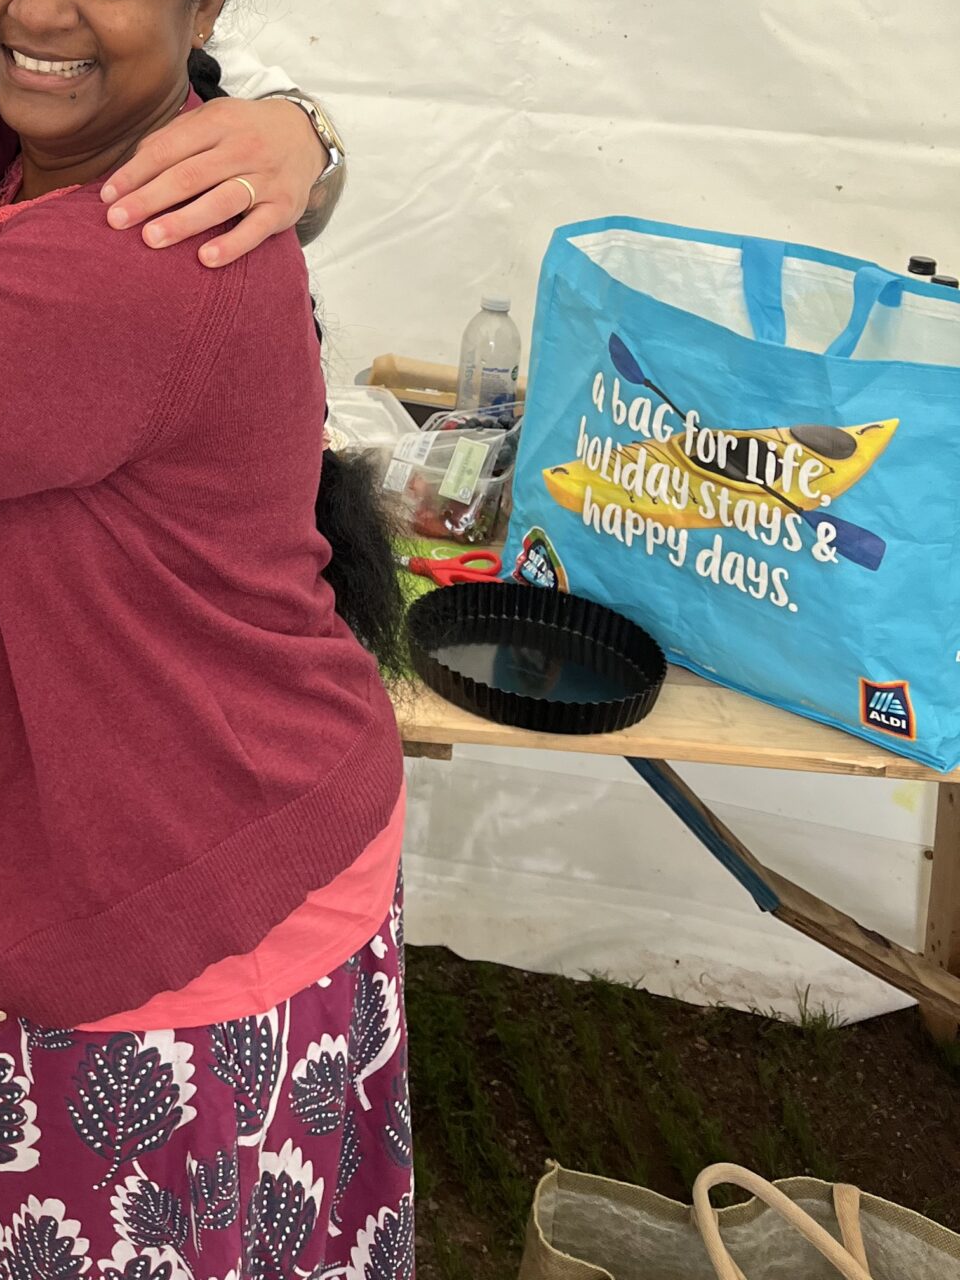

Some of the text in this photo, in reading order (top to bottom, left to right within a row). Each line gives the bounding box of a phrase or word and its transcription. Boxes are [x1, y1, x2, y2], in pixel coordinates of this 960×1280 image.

[592, 372, 606, 413] a
[682, 409, 738, 469] for
[582, 486, 799, 613] happy days.
[811, 521, 839, 564] &
[869, 710, 907, 729] ALDI
